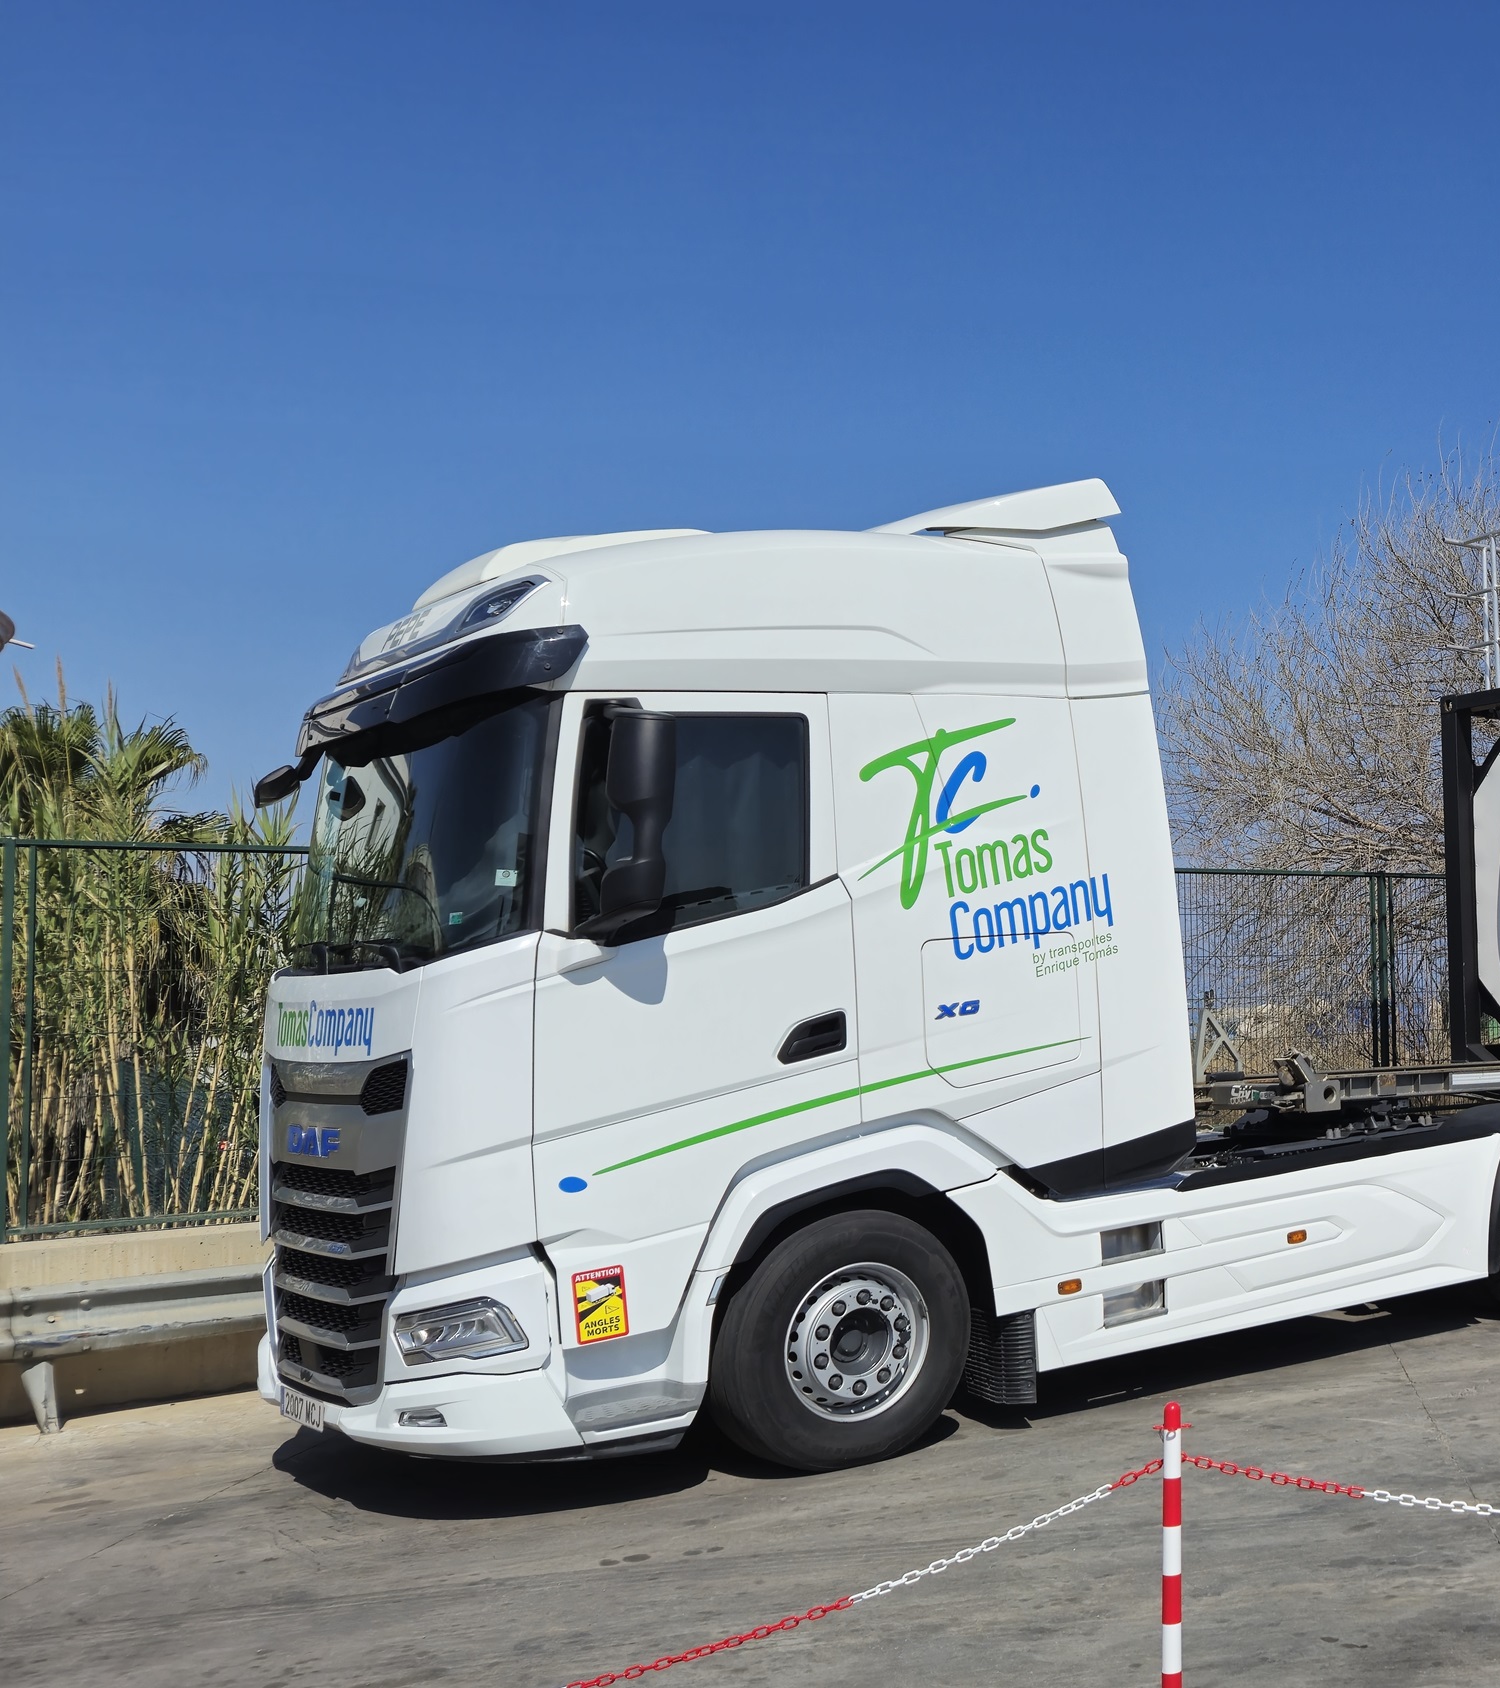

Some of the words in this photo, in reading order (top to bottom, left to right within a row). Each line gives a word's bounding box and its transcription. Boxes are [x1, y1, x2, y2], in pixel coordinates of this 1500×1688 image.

[381, 608, 432, 653] PEPE
[934, 828, 1053, 899] Tomas
[949, 873, 1114, 960] Company
[1032, 952, 1046, 965] by
[1049, 932, 1113, 953] transportes
[1035, 956, 1080, 978] Enrique
[1082, 944, 1119, 963] Tomás
[934, 999, 980, 1020] XG
[287, 1124, 342, 1159] DAF
[575, 1267, 621, 1282] ATTENTION
[584, 1315, 620, 1330] ANGLES
[587, 1323, 620, 1337] MORTS
[285, 1391, 304, 1420] 2007
[305, 1400, 321, 1428] MCJ
